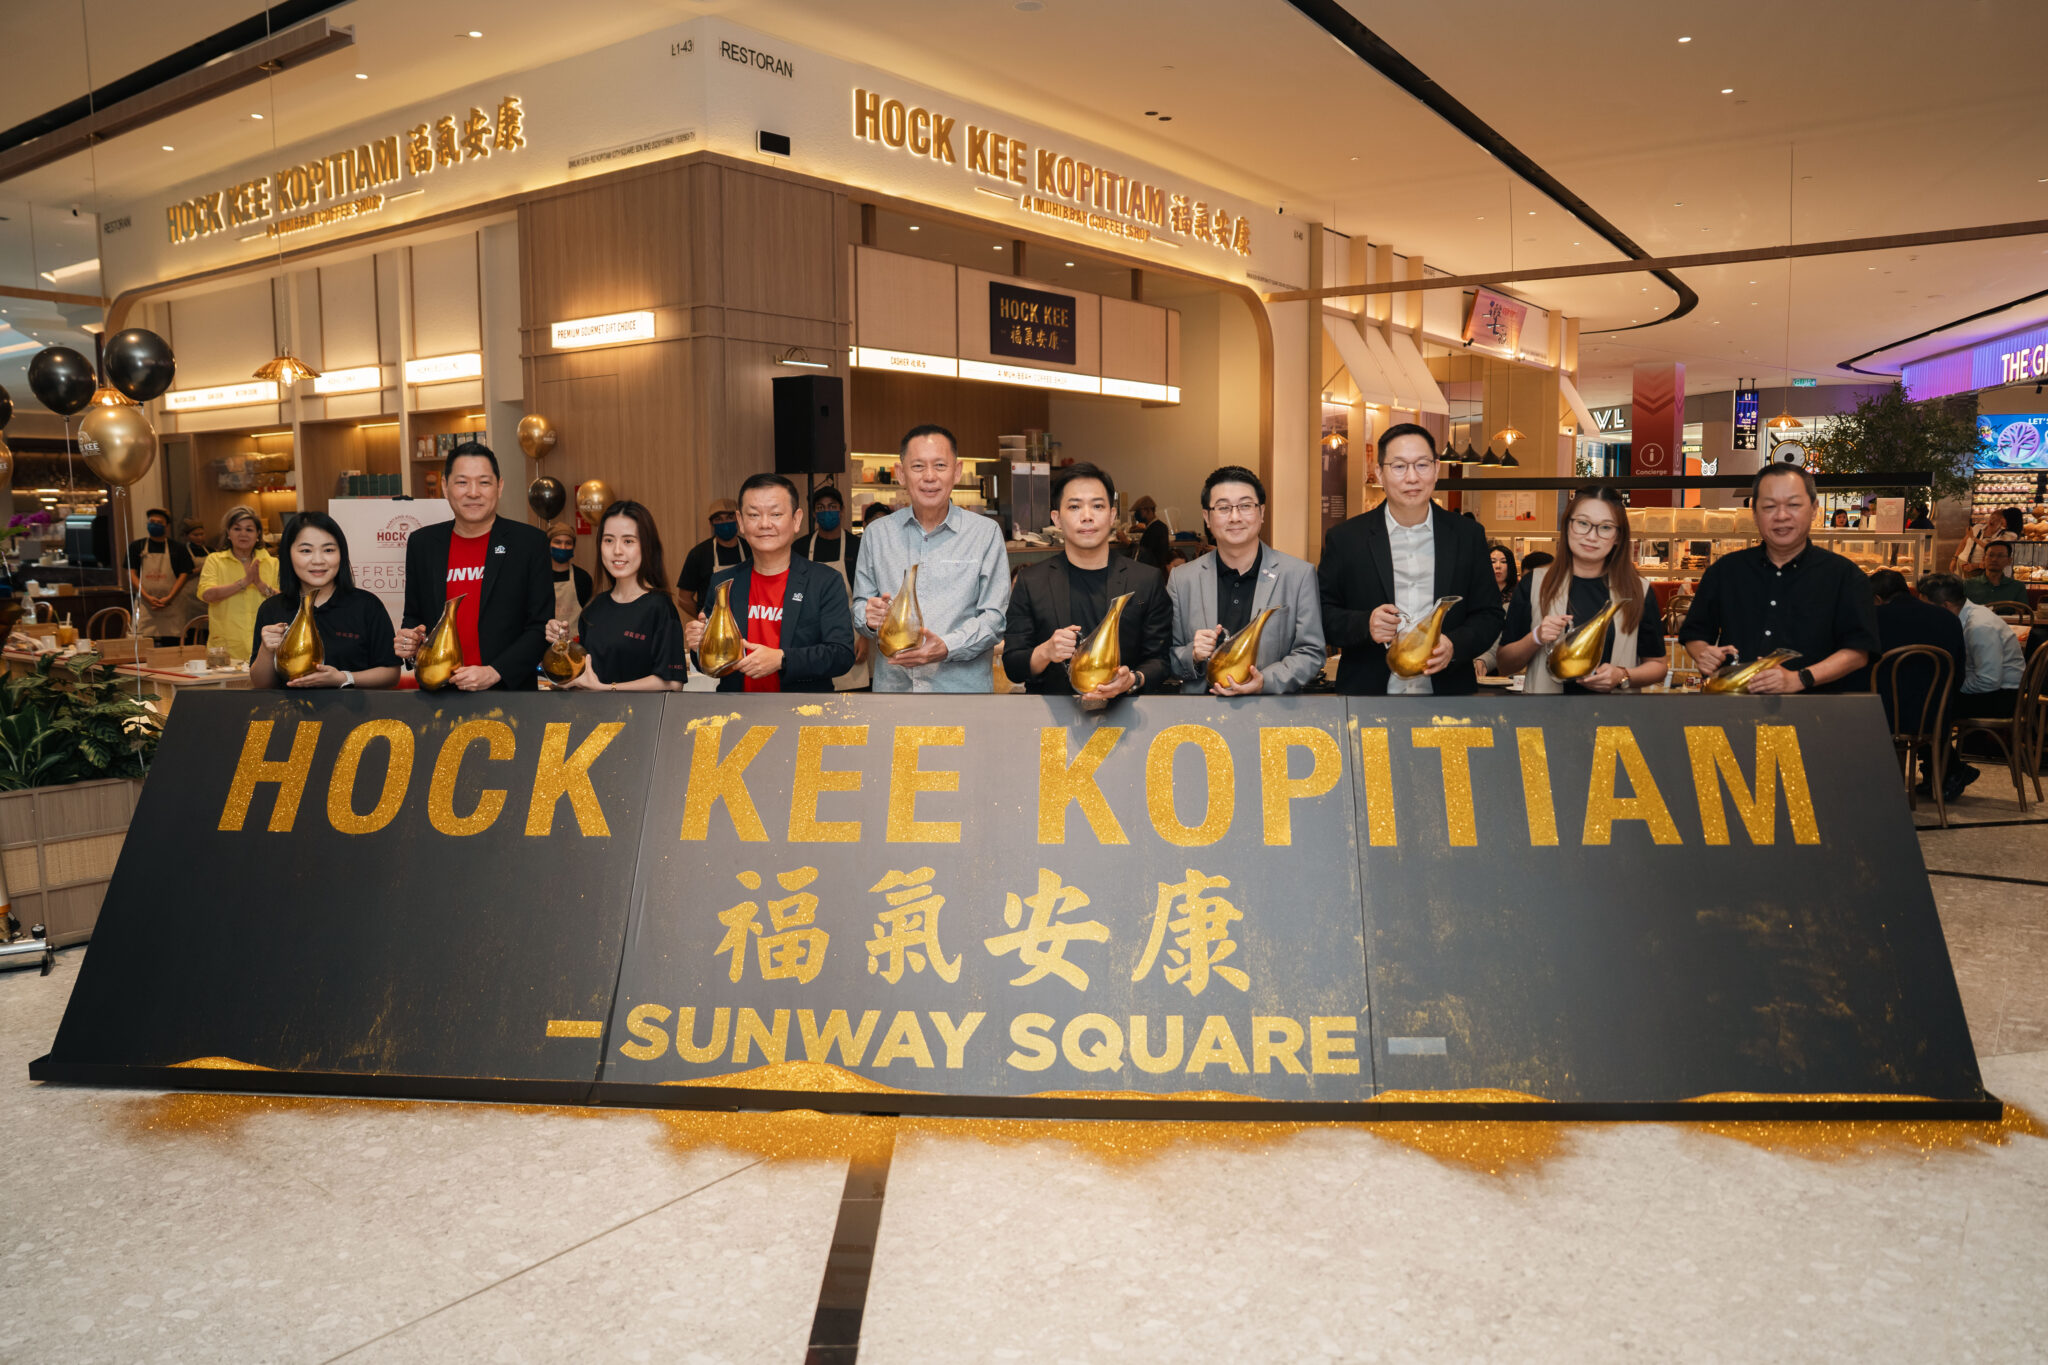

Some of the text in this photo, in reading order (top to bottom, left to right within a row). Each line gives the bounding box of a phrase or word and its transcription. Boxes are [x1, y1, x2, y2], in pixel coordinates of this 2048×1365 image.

[671, 39, 693, 56] L1-43
[720, 40, 793, 78] RESTORAN
[404, 95, 526, 178] 福氣安康
[853, 87, 1166, 228] HOCK KEE KOPITIAM
[166, 135, 402, 245] HOCK KEE KOPITIAM
[320, 200, 356, 225] COFFEE
[354, 193, 385, 216] SHOP
[1020, 194, 1151, 243] A MUHIBBAH COFFEE SHOP
[1168, 193, 1252, 257] 福氣安康
[557, 319, 637, 341] PREMIUM GOURMET GIFT CHOICE
[1000, 297, 1069, 328] HOCK KEE
[2001, 348, 2030, 383] THE
[376, 531, 407, 542] HOCK
[217, 718, 1822, 847] HOCK KEE KOPITIAM
[713, 866, 1252, 997] 福氣安康
[619, 1002, 1361, 1076] SUNWAY SQUARE
